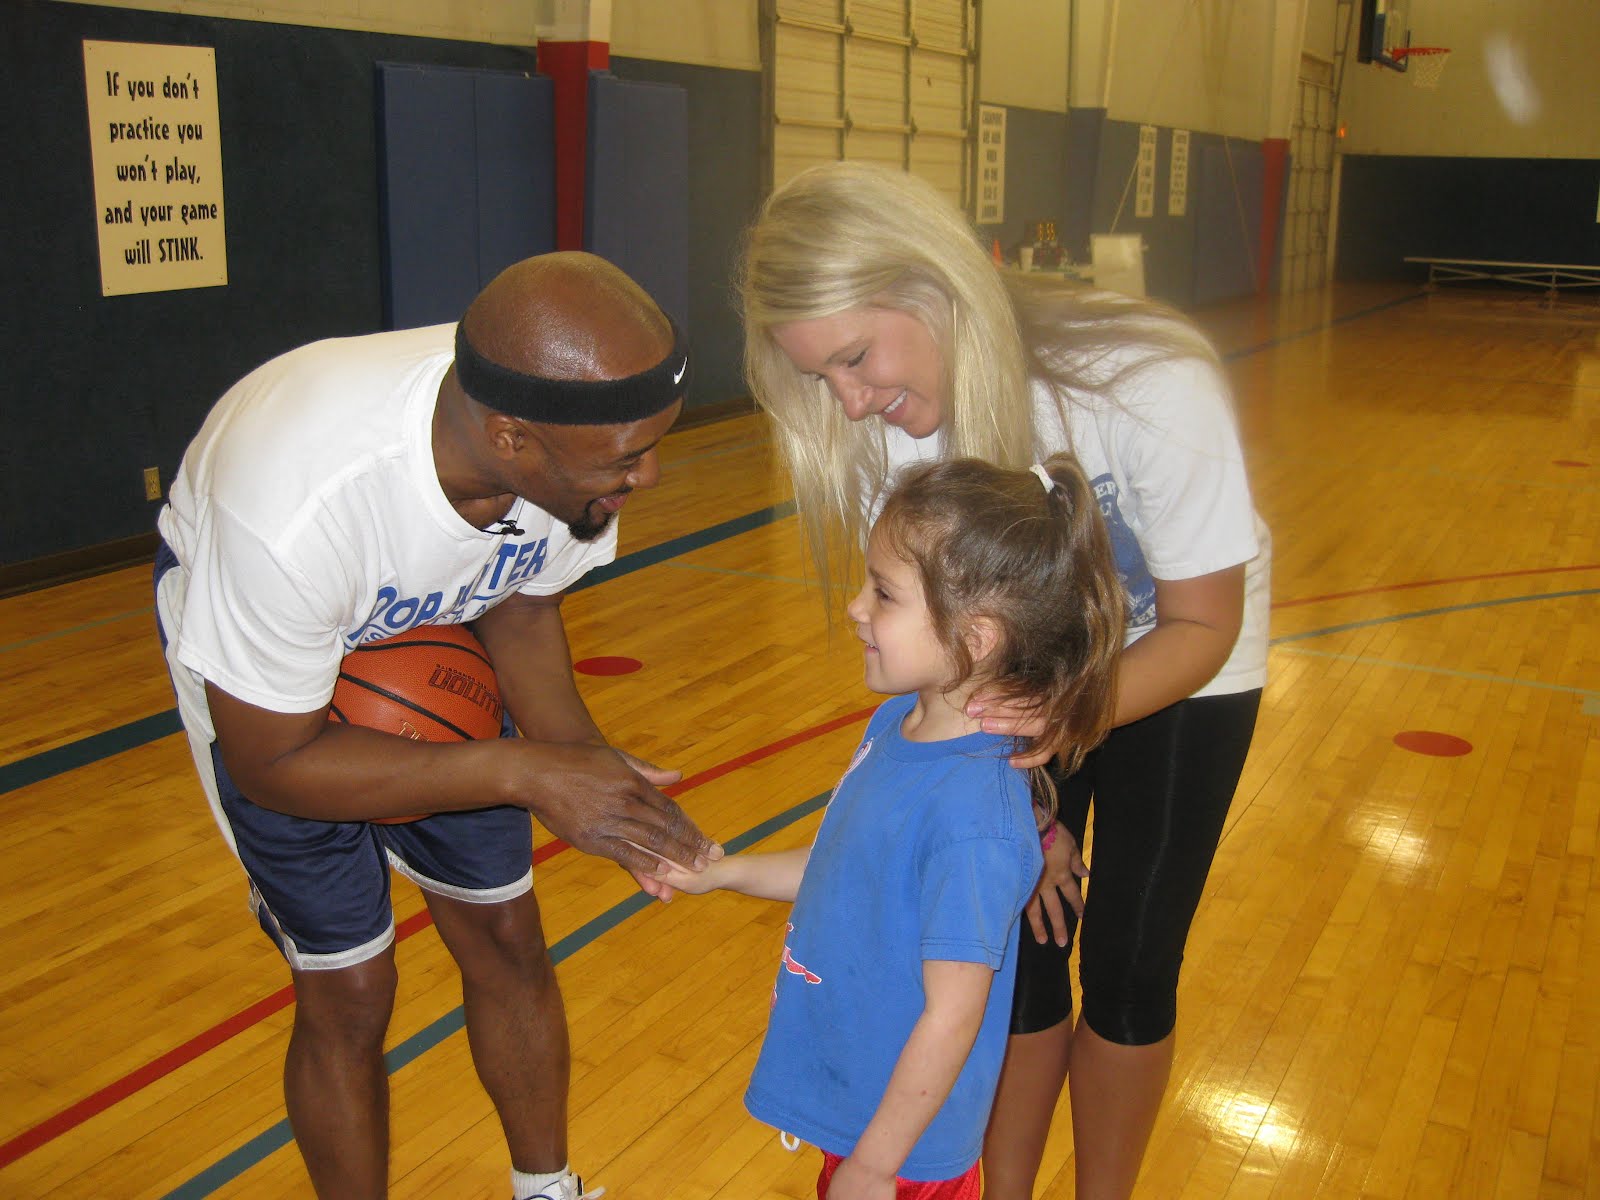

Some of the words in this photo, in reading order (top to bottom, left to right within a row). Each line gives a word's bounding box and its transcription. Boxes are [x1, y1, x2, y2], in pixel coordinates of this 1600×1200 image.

[105, 70, 120, 97] If
[127, 80, 155, 102] you
[162, 72, 200, 100] don't
[109, 115, 170, 144] practice
[176, 123, 203, 145] you
[116, 153, 158, 182] won't
[165, 155, 201, 185] play,
[104, 199, 133, 225] and
[139, 204, 174, 227] your
[180, 203, 218, 226] game
[124, 238, 152, 266] will
[158, 236, 204, 264] STINK.
